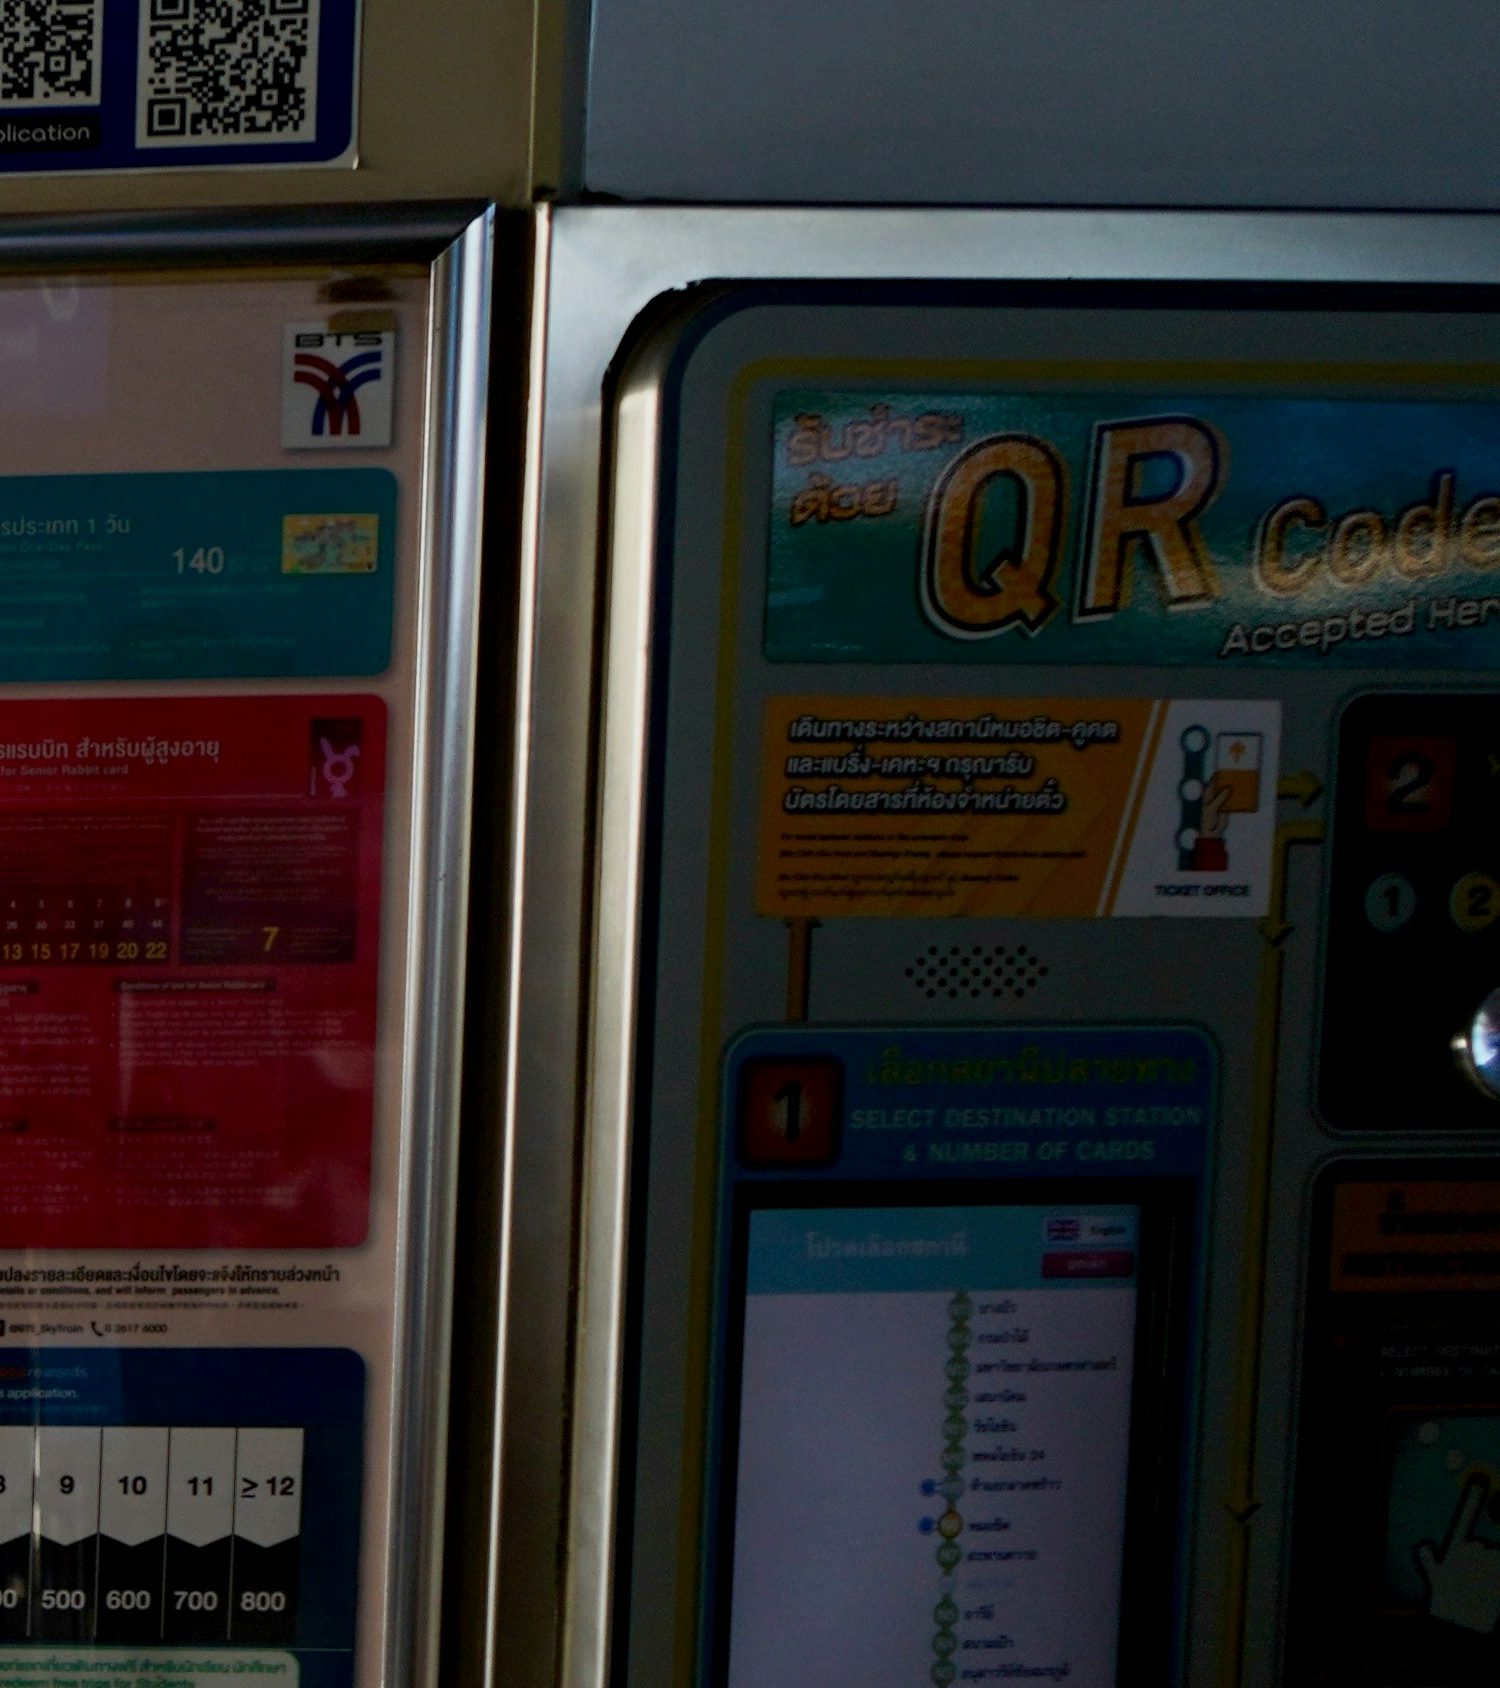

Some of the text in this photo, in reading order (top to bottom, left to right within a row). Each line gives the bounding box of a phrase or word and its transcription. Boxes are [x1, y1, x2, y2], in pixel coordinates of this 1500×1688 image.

[922, 414, 1231, 642] QR
[171, 547, 226, 575] 140
[60, 1476, 75, 1494] 9
[118, 1476, 147, 1495] 10
[187, 1477, 214, 1496] 11
[42, 1590, 86, 1610] 500
[106, 1591, 151, 1611] 600
[174, 1591, 218, 1611] 700
[241, 1592, 286, 1612] 800
